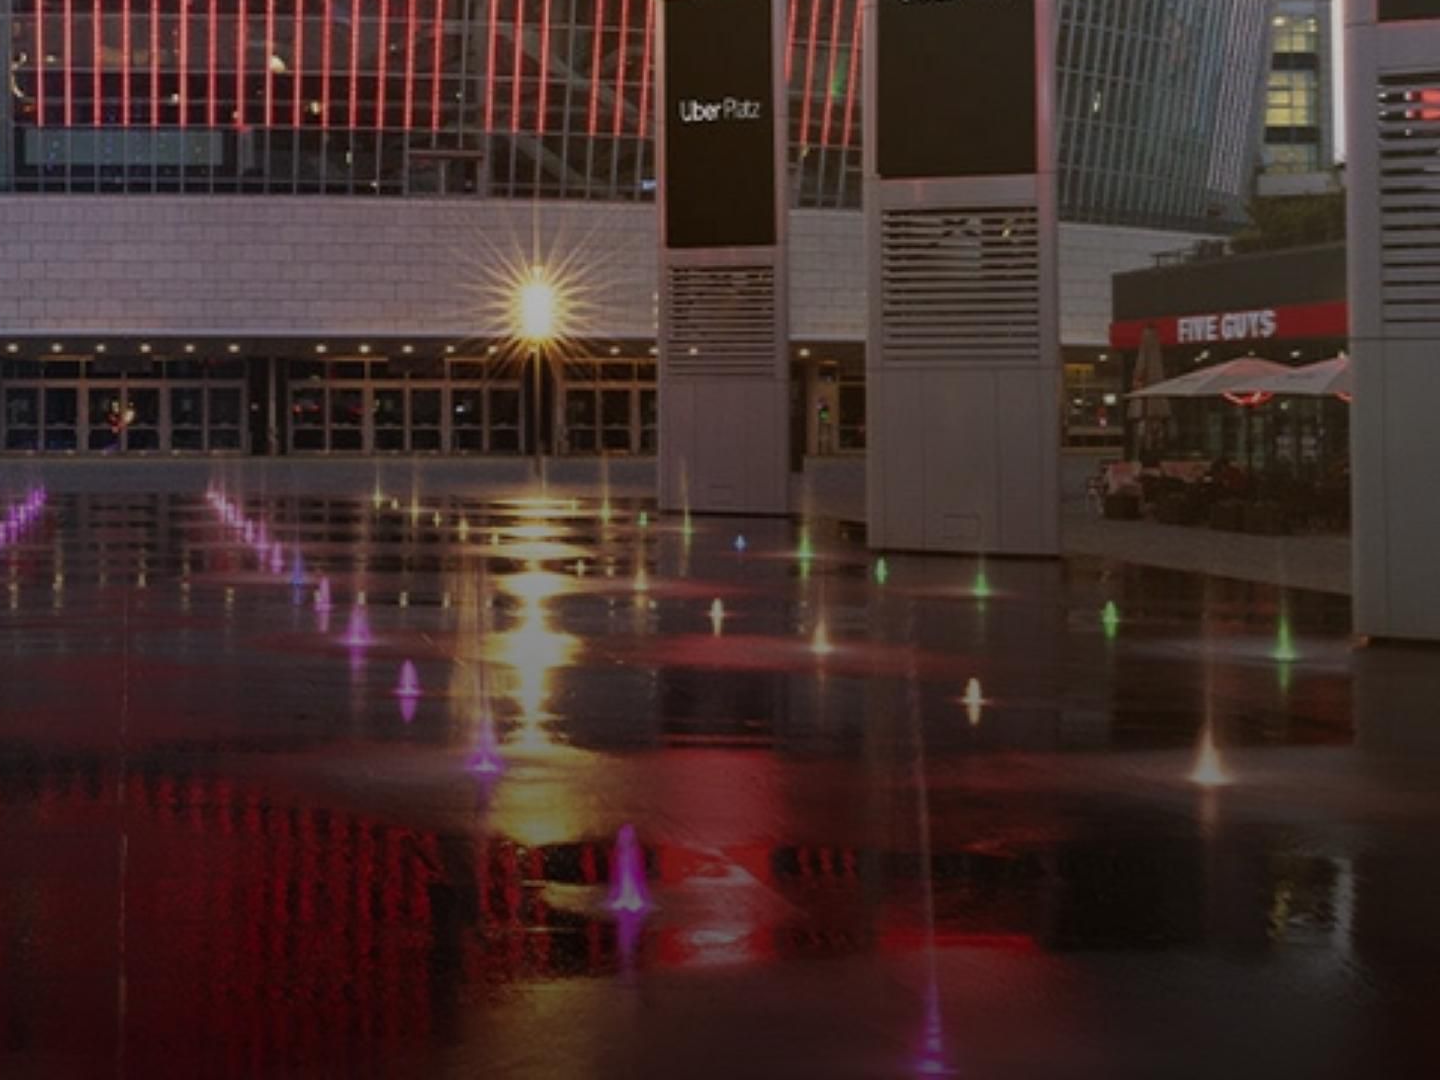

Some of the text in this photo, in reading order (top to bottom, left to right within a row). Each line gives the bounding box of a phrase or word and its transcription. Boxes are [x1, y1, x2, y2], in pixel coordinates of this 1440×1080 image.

[679, 100, 721, 122] Uber
[1177, 309, 1277, 343] FIVE GUYS
